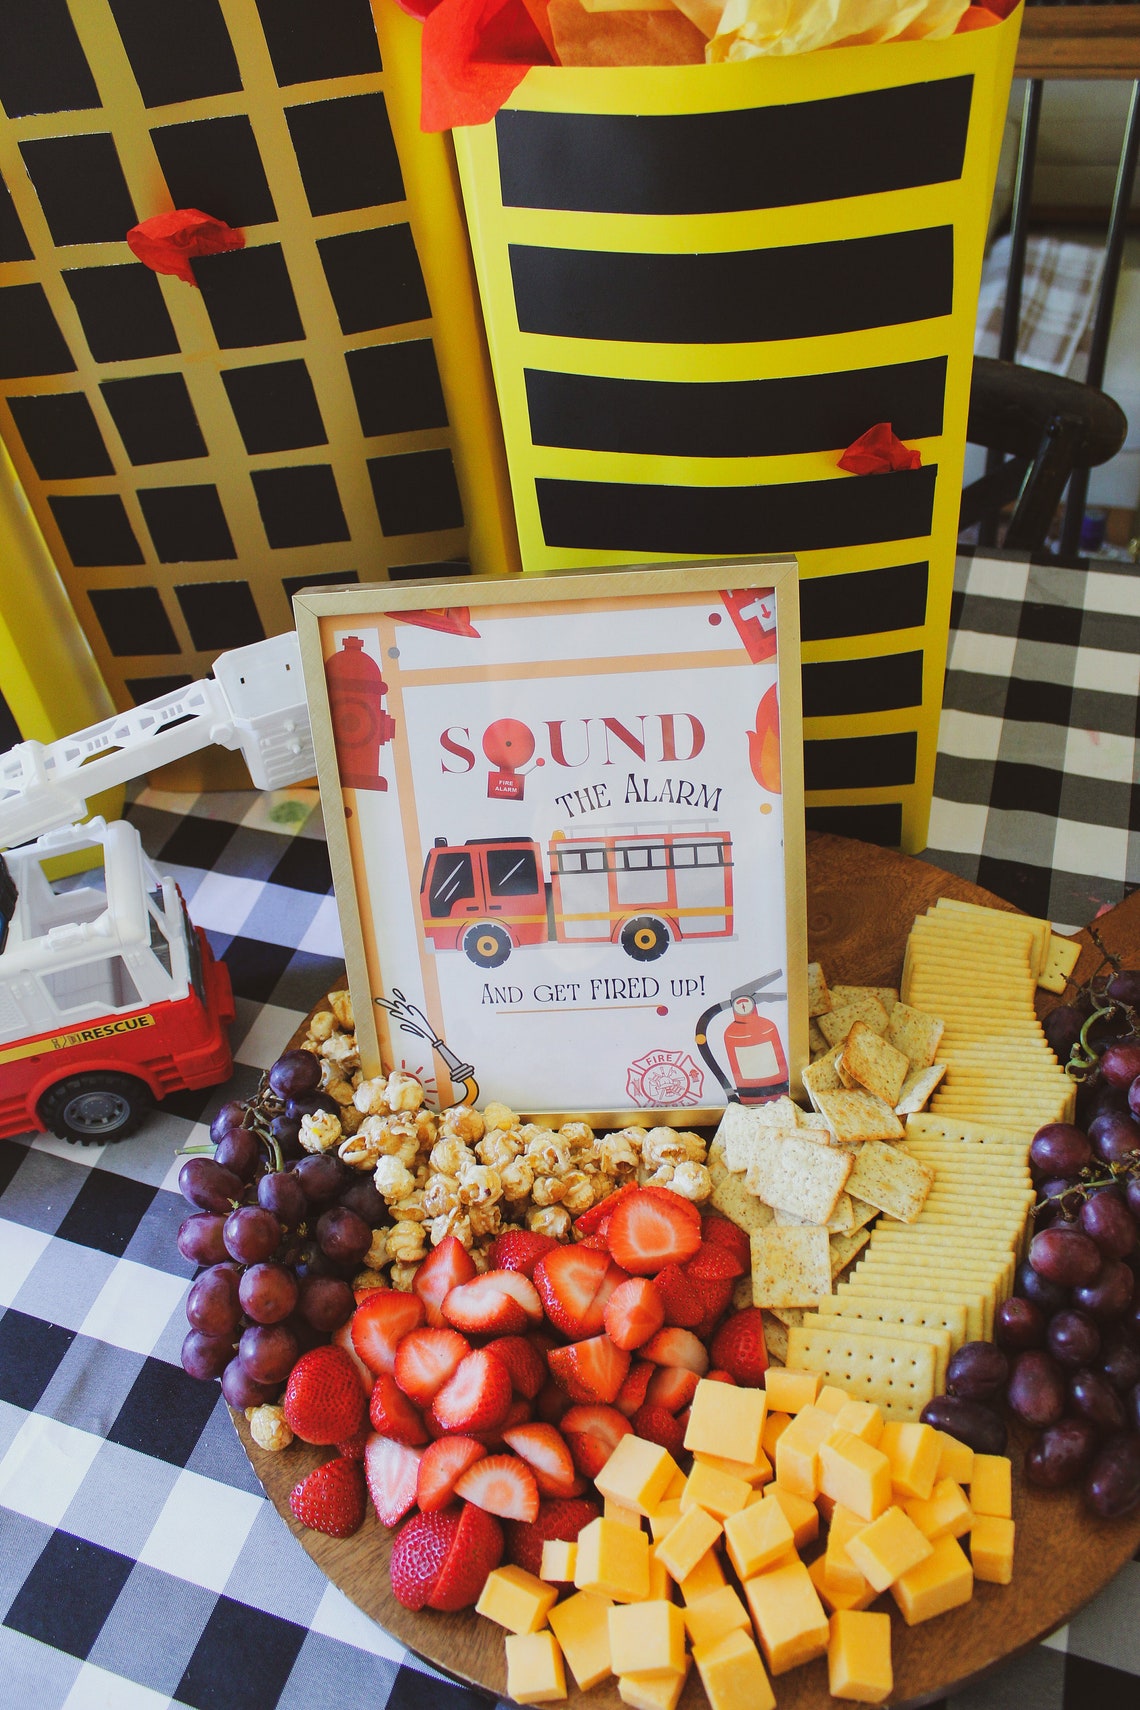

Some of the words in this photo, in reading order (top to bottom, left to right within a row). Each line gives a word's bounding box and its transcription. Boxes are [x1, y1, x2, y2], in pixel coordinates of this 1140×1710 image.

[555, 783, 611, 818] THE
[624, 773, 722, 812] ALARM
[481, 983, 523, 1004] AND
[533, 983, 580, 1003] GET
[590, 976, 660, 1000] FIRED
[81, 1016, 150, 1041] RESCUE
[646, 1054, 673, 1066] FIRE
